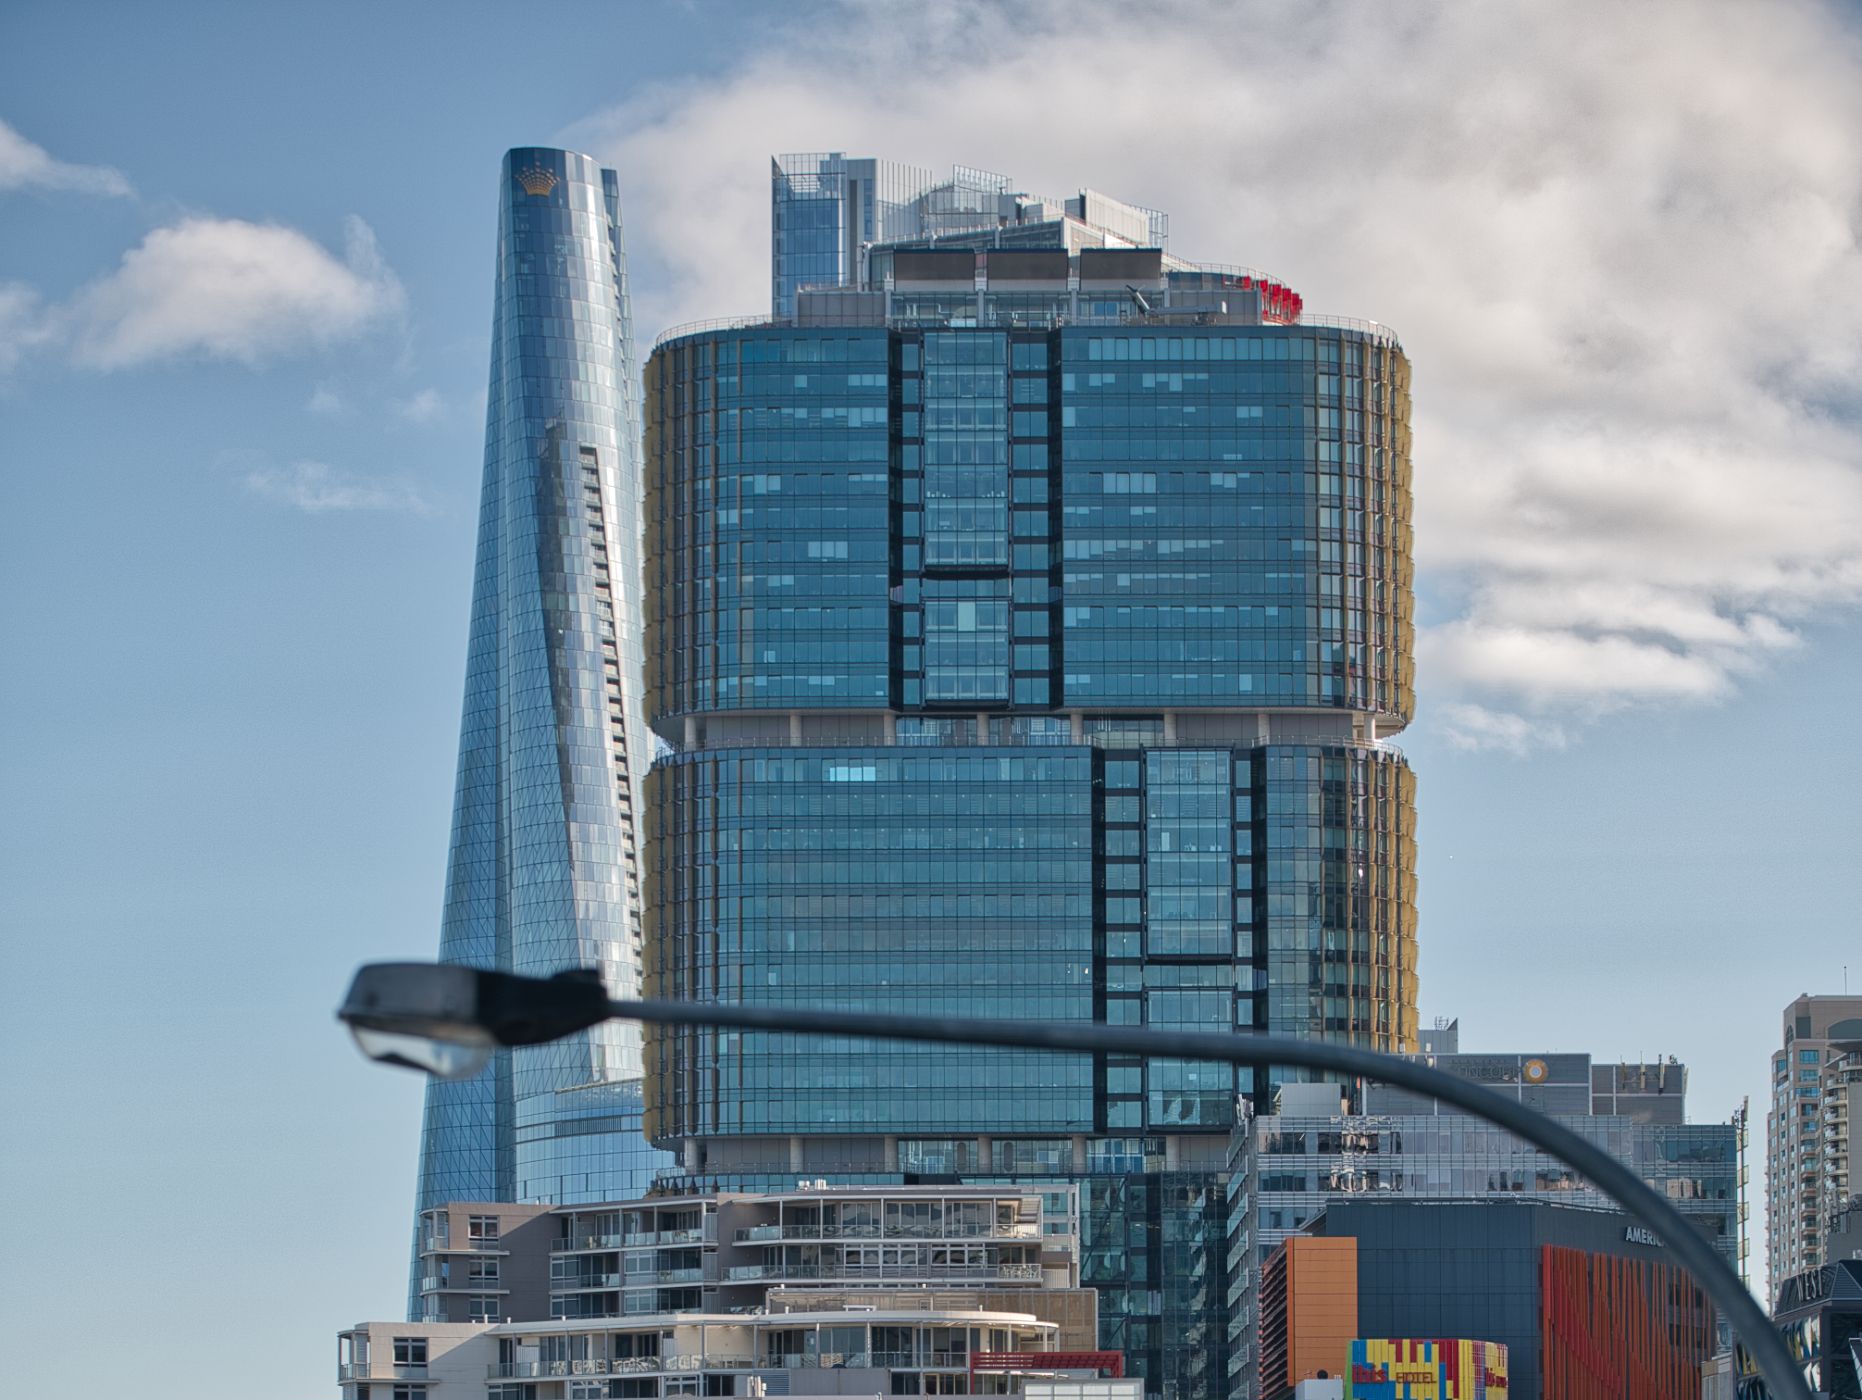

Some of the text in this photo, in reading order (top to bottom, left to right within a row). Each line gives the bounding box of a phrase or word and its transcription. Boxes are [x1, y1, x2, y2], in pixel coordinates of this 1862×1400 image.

[1626, 1226, 1664, 1247] AMERIC
[1352, 1364, 1436, 1384] ibis HOTEL
